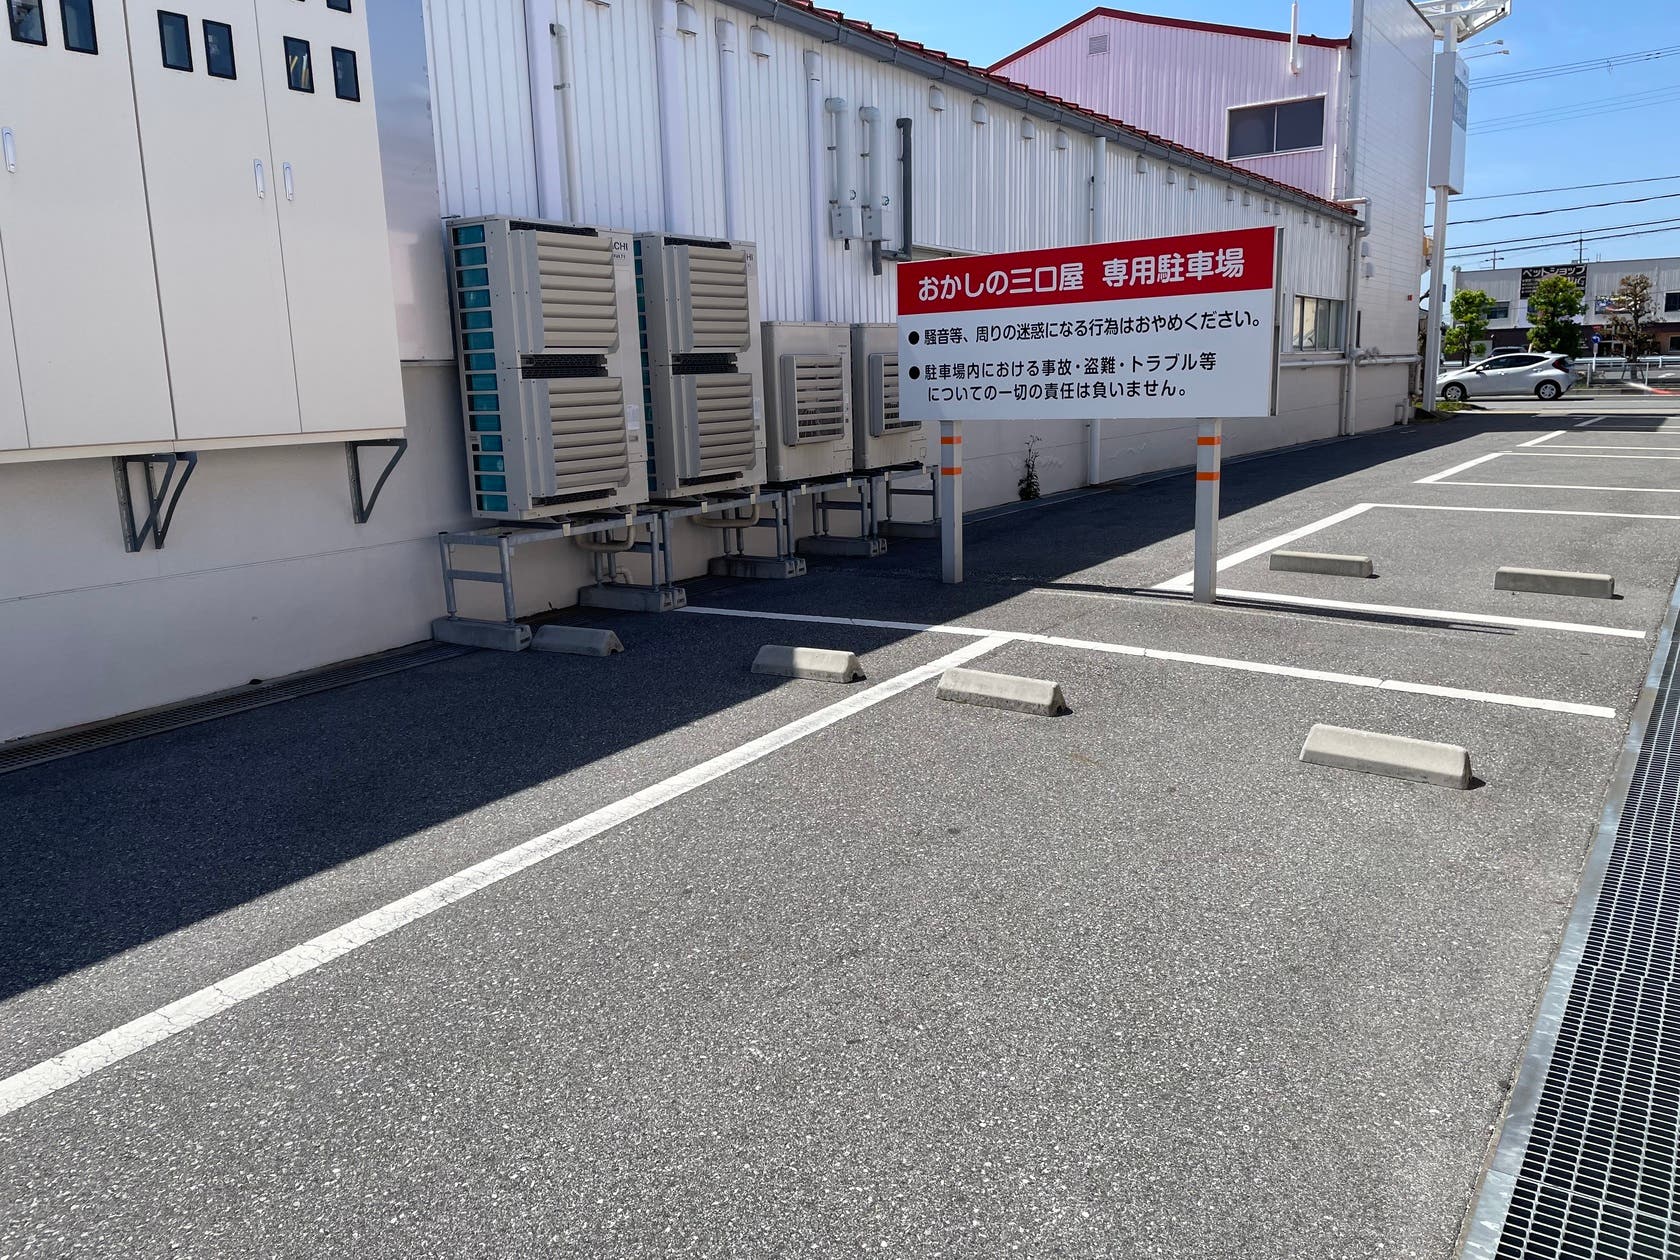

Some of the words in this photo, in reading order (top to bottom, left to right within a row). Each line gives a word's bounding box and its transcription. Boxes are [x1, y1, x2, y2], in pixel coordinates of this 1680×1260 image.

[919, 263, 1084, 302] おかしの三口屋
[1102, 248, 1245, 286] 専用駐車場
[924, 310, 1260, 346] 騒音等、周りの迷惑になる行為はおやめください。
[924, 351, 1217, 381] 駐車場内における事故・盗難・トラブル等
[928, 379, 1186, 403] についての一切の責任は負いません。
